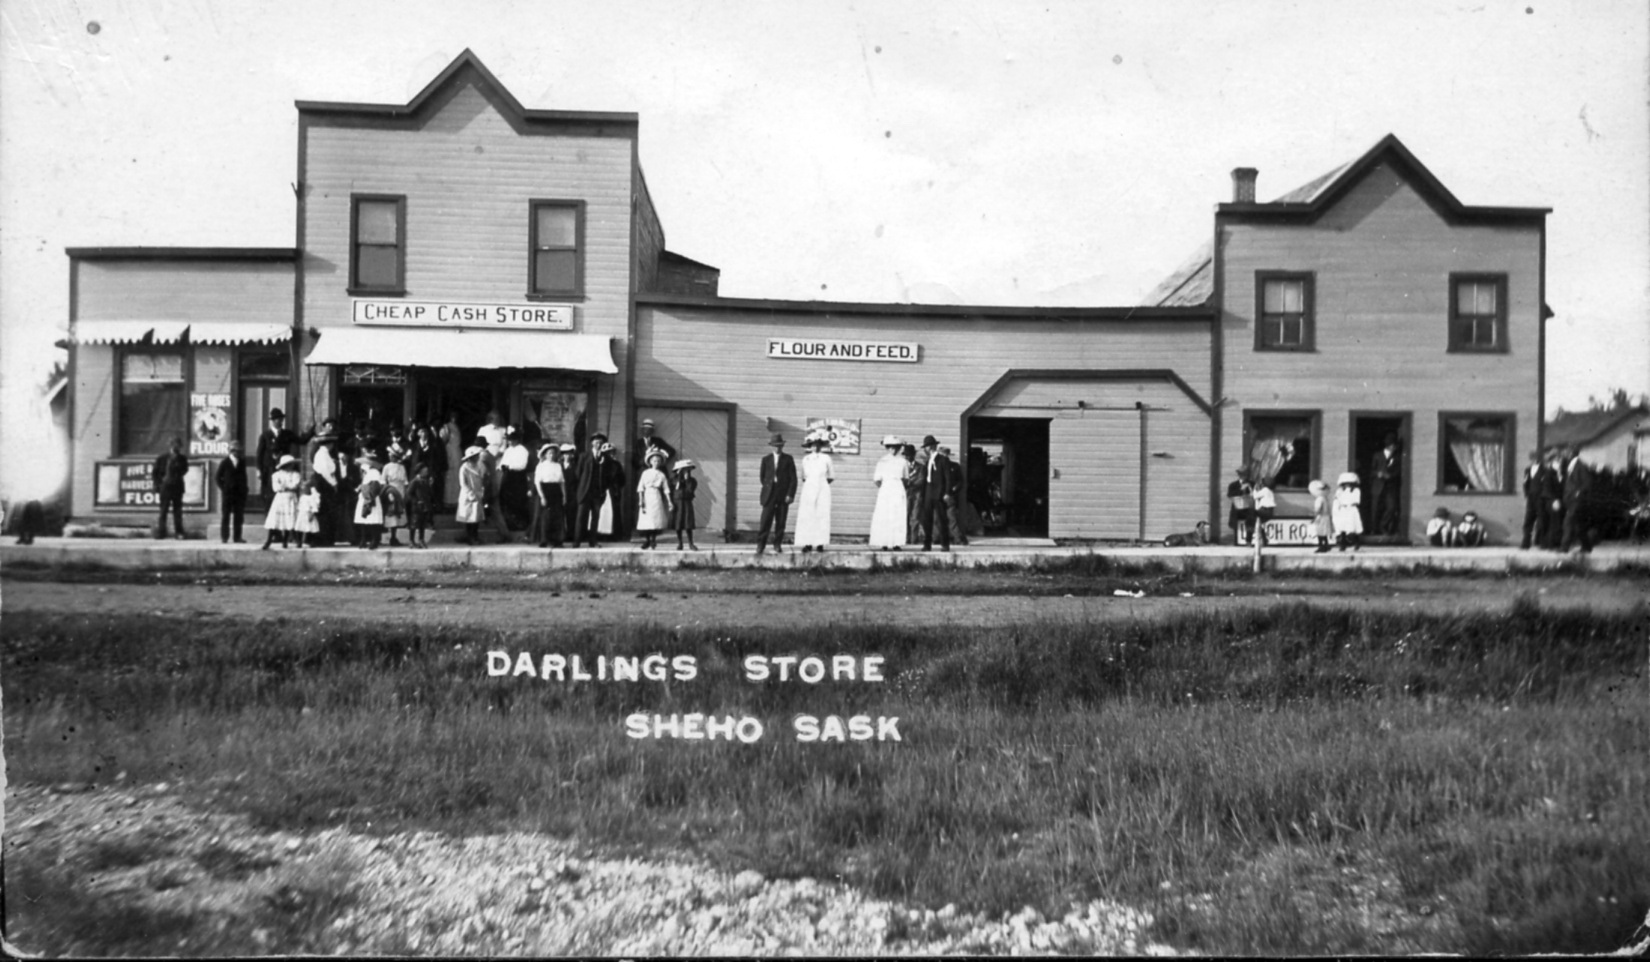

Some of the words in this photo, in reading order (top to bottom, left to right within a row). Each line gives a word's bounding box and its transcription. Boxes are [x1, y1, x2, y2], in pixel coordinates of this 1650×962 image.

[364, 303, 426, 320] CHEAP
[437, 305, 487, 322] CASH
[496, 306, 563, 323] STORE.
[769, 341, 826, 356] FLOUR
[830, 344, 862, 357] AND
[866, 345, 914, 359] FEED.
[190, 440, 230, 455] FLOUR
[125, 491, 161, 505] FLO
[1240, 523, 1283, 540] LCH
